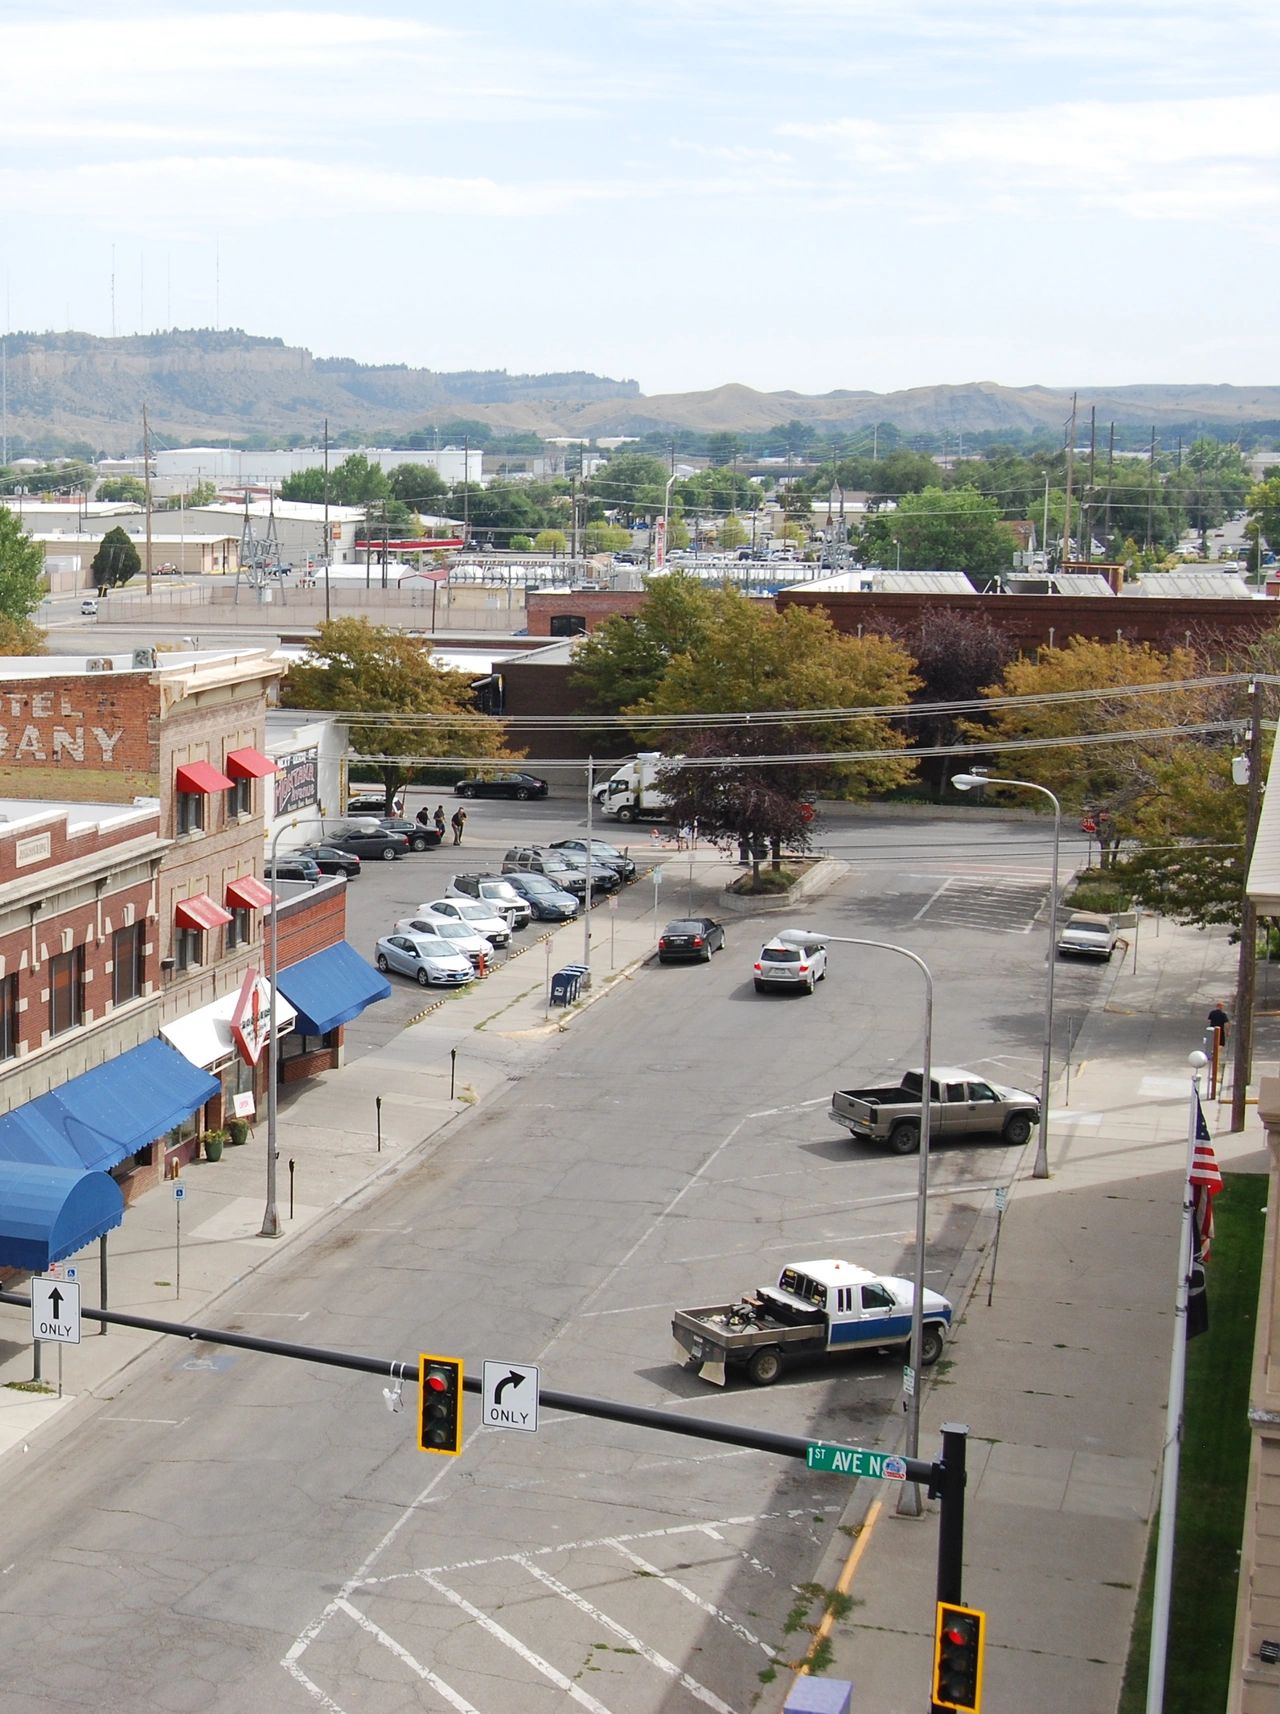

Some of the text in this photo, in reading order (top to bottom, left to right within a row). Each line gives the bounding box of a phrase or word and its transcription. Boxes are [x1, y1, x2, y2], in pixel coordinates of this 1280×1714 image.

[40, 1322, 72, 1337] ONLY
[490, 1408, 529, 1425] ONLY
[808, 1447, 881, 1476] 1ST AVE N
